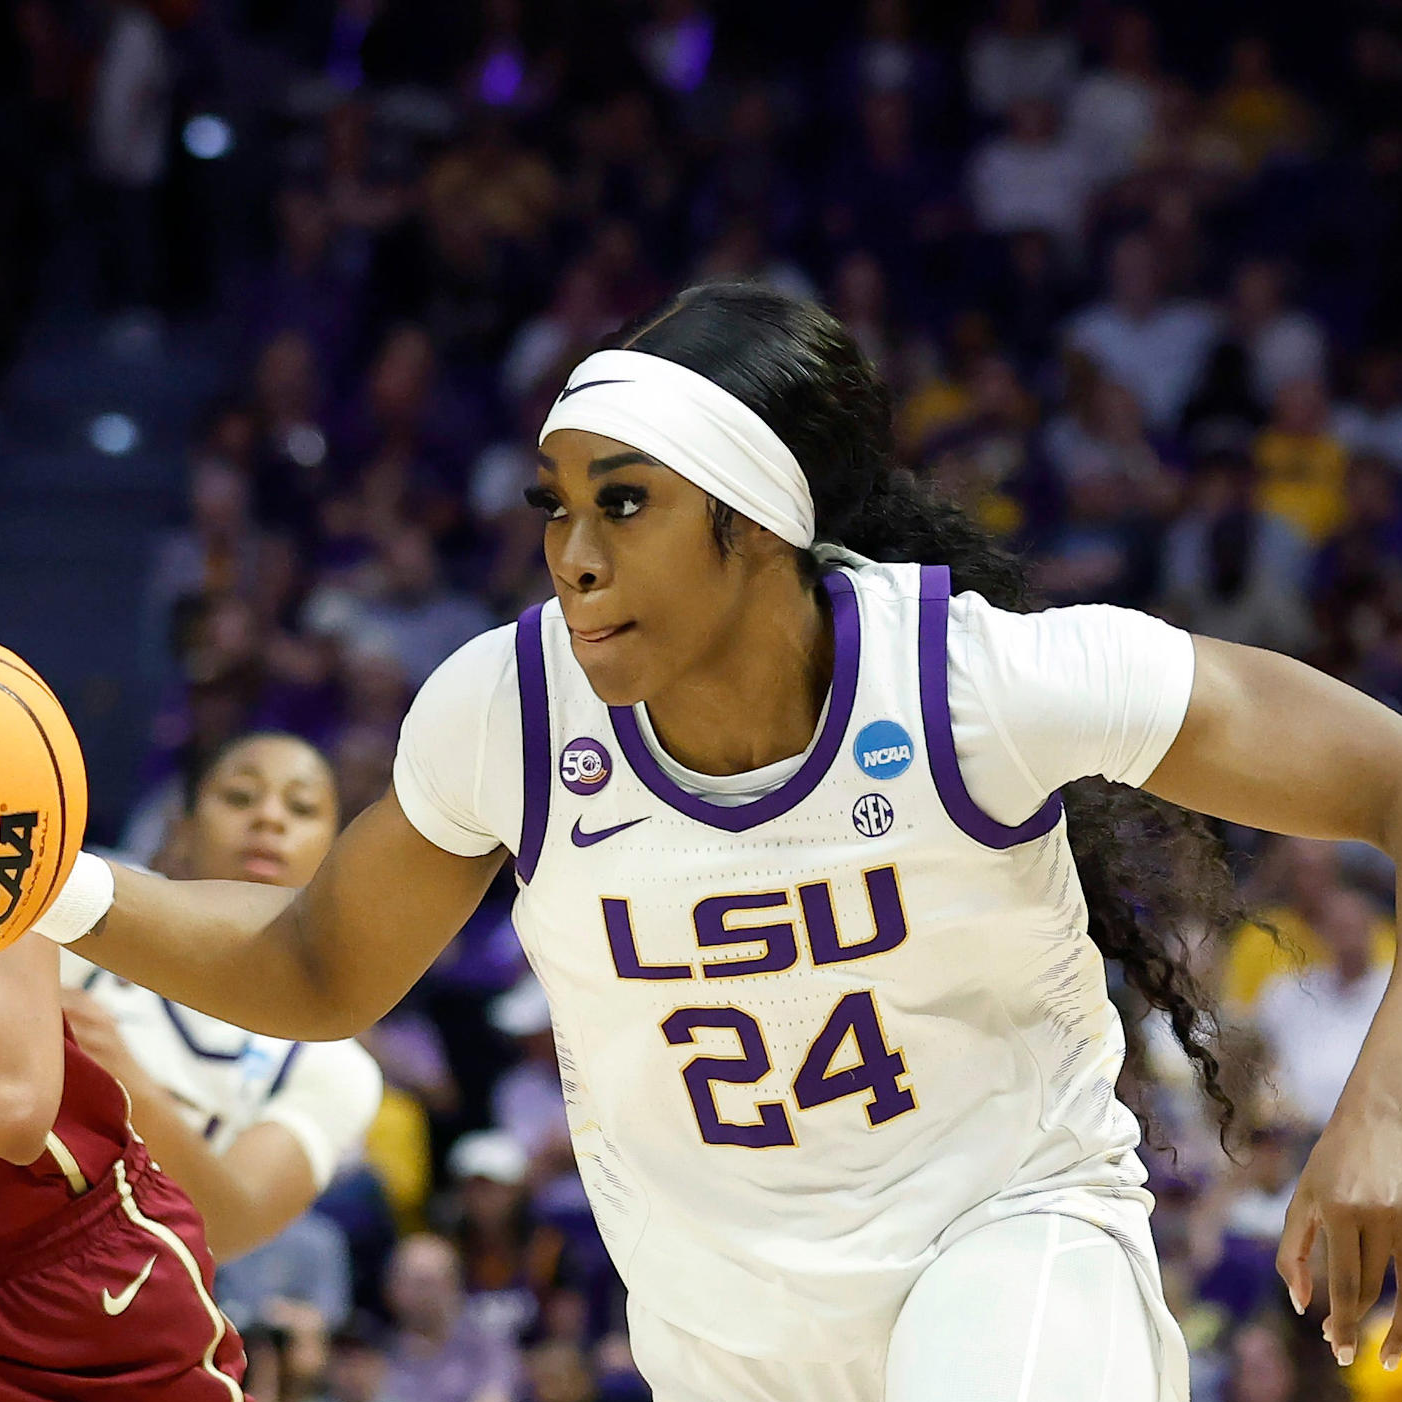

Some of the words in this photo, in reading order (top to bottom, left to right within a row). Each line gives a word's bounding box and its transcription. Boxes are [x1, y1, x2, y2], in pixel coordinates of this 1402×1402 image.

[862, 744, 911, 768] NCAA
[853, 794, 894, 837] SEC
[599, 863, 910, 981] LSU
[658, 988, 919, 1151] 24
